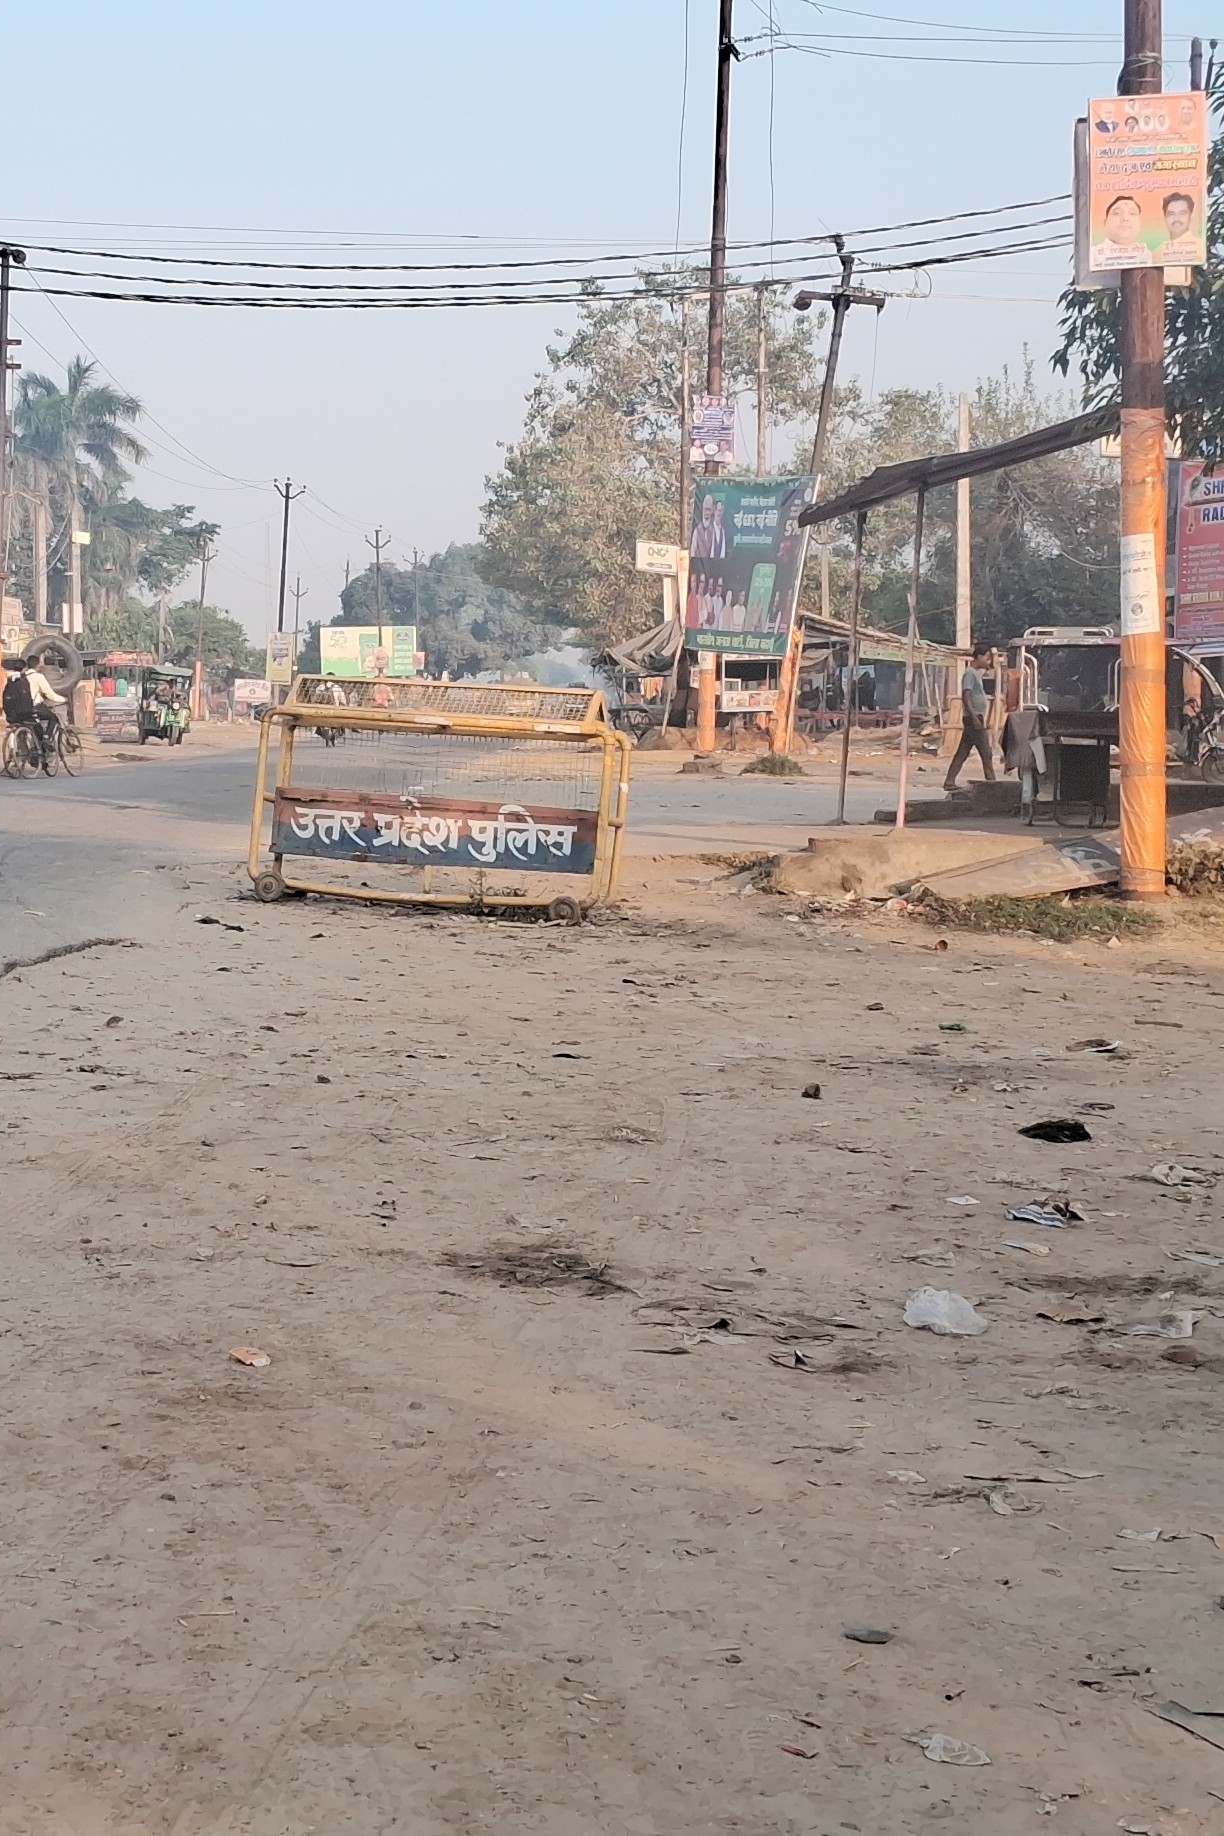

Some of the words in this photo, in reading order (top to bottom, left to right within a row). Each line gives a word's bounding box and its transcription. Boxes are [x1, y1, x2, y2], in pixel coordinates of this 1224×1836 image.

[290, 805, 366, 847] उत्तर
[371, 796, 461, 855] प्रदेश
[467, 804, 577, 863] पुलिस
